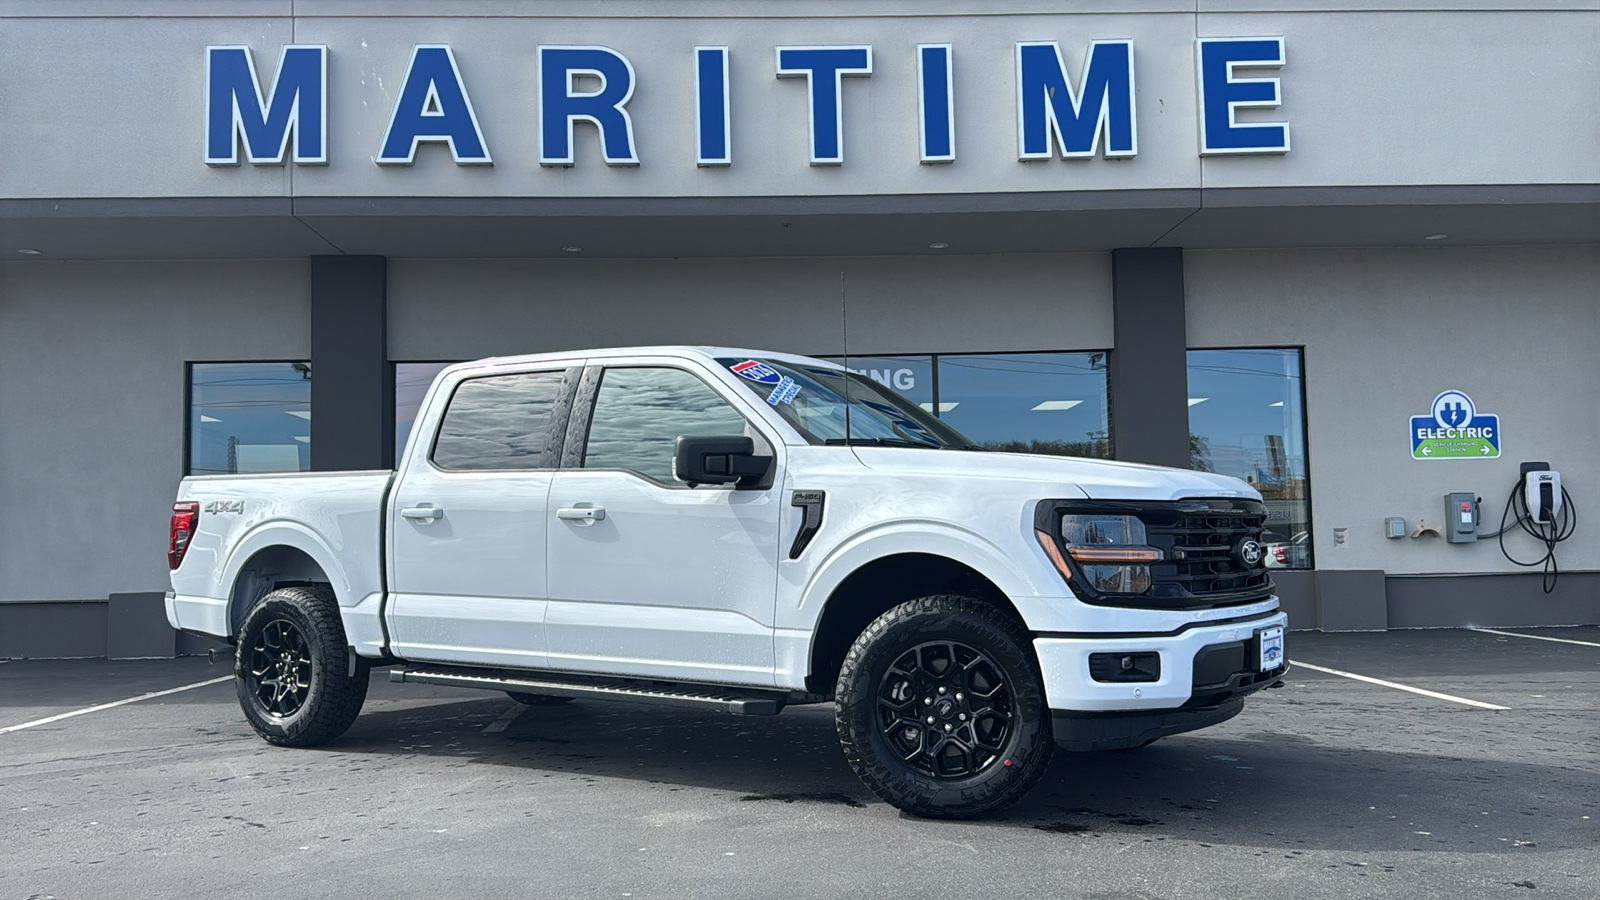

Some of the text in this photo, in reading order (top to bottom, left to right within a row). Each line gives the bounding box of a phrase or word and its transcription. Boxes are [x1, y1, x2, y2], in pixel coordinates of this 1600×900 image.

[204, 36, 1291, 166] MARITIME
[1417, 427, 1493, 439] ELECTRIC
[1538, 474, 1553, 482] Ford
[1243, 543, 1260, 561] Ford
